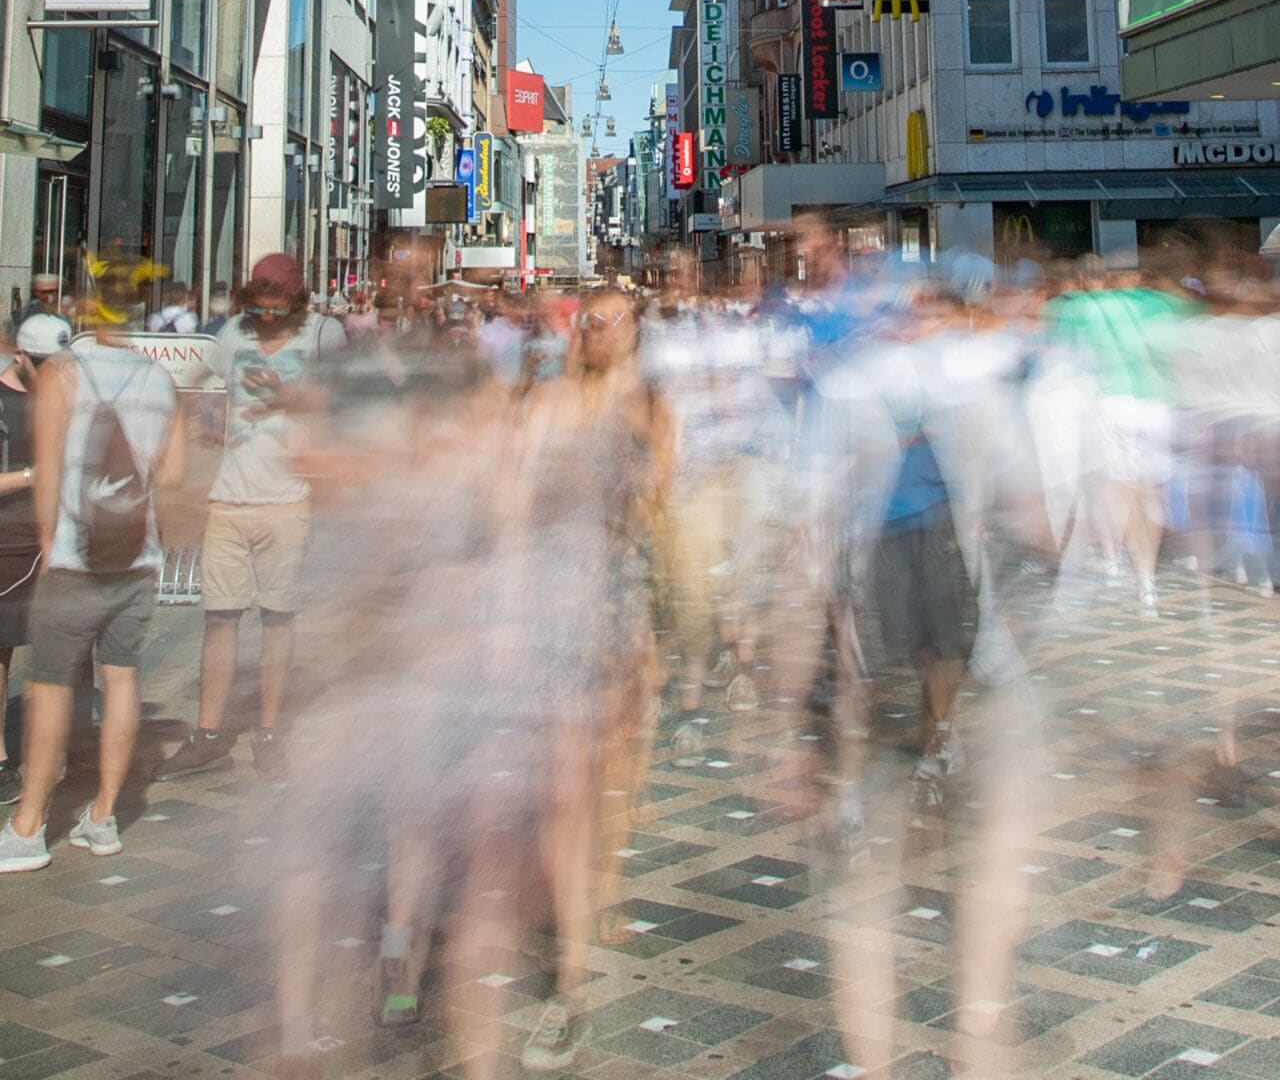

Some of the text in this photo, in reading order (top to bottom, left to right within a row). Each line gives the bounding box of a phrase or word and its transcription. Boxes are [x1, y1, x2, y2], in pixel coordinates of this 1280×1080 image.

[515, 89, 538, 105] ESPRIT
[704, 3, 726, 188] DEICHMANN
[782, 77, 792, 149] intimissimi
[811, 45, 831, 112] Locker
[386, 74, 401, 192] JACK JONES
